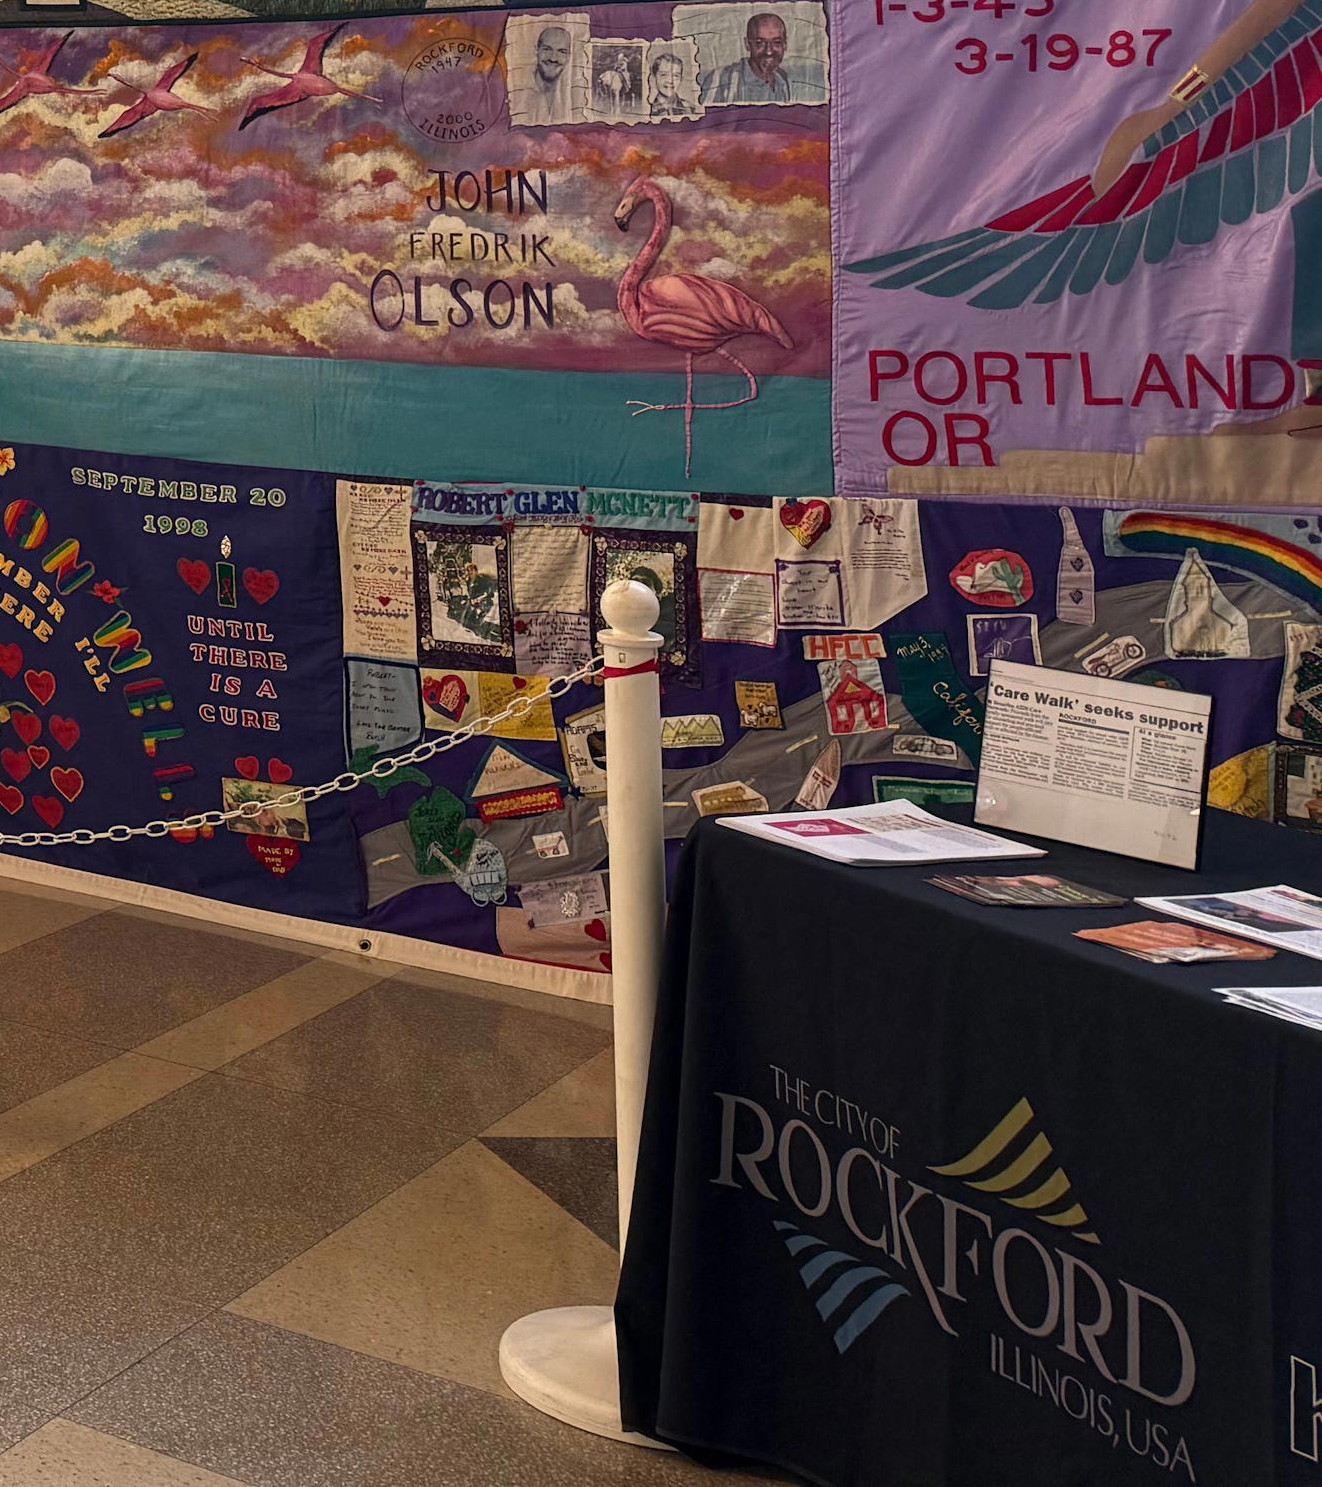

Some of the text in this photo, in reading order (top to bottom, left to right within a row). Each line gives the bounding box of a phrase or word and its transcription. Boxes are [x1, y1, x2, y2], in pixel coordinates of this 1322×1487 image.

[415, 43, 484, 71] ROCKFORD
[431, 56, 462, 73] 1947
[954, 29, 1173, 75] 3-19-87
[419, 118, 485, 140] ILLINOIS
[437, 112, 473, 125] 2000
[426, 168, 547, 215] JOHN
[408, 231, 556, 268] FREDRIK
[369, 267, 556, 332] OLSON
[869, 350, 1297, 410] PORTLAND
[881, 411, 998, 467] OR
[71, 467, 287, 508] SEPTEMBER 20
[418, 486, 692, 518] ROBERT GLEN MCNETT
[143, 515, 209, 538] 1998
[187, 615, 275, 642] UNTIL
[189, 643, 287, 672] THERE
[809, 634, 883, 660] HFCC
[74, 638, 112, 693] I'LL
[210, 674, 278, 699] IS A
[198, 704, 281, 732] CURE
[990, 681, 1204, 734] 'Care Walk' seeks support
[1059, 713, 1097, 725] ROCKFORD
[769, 1064, 901, 1160] THE CITY OF
[710, 1092, 1196, 1407] ROCKFORD
[990, 1333, 1196, 1483] ILLINOIS, USA
